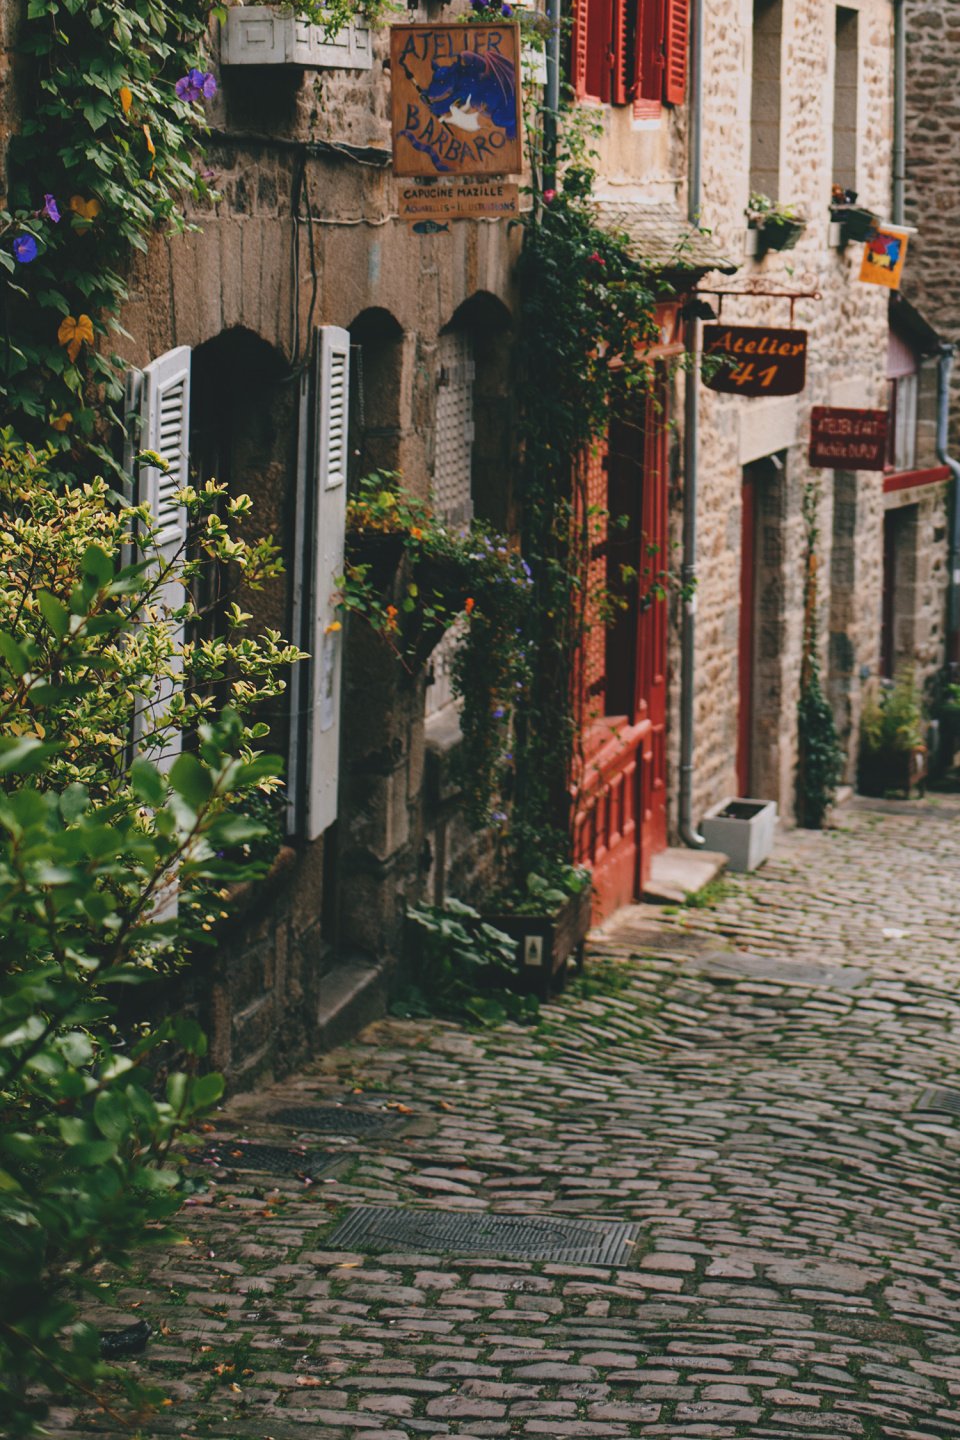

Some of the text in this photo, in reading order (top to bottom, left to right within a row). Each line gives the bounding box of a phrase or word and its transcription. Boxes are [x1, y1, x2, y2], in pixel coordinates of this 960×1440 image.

[402, 31, 504, 61] ATELIER
[405, 103, 507, 164] BARBARO
[706, 331, 805, 356] Atelier
[728, 362, 779, 388] 41
[817, 417, 852, 436] ATELIER
